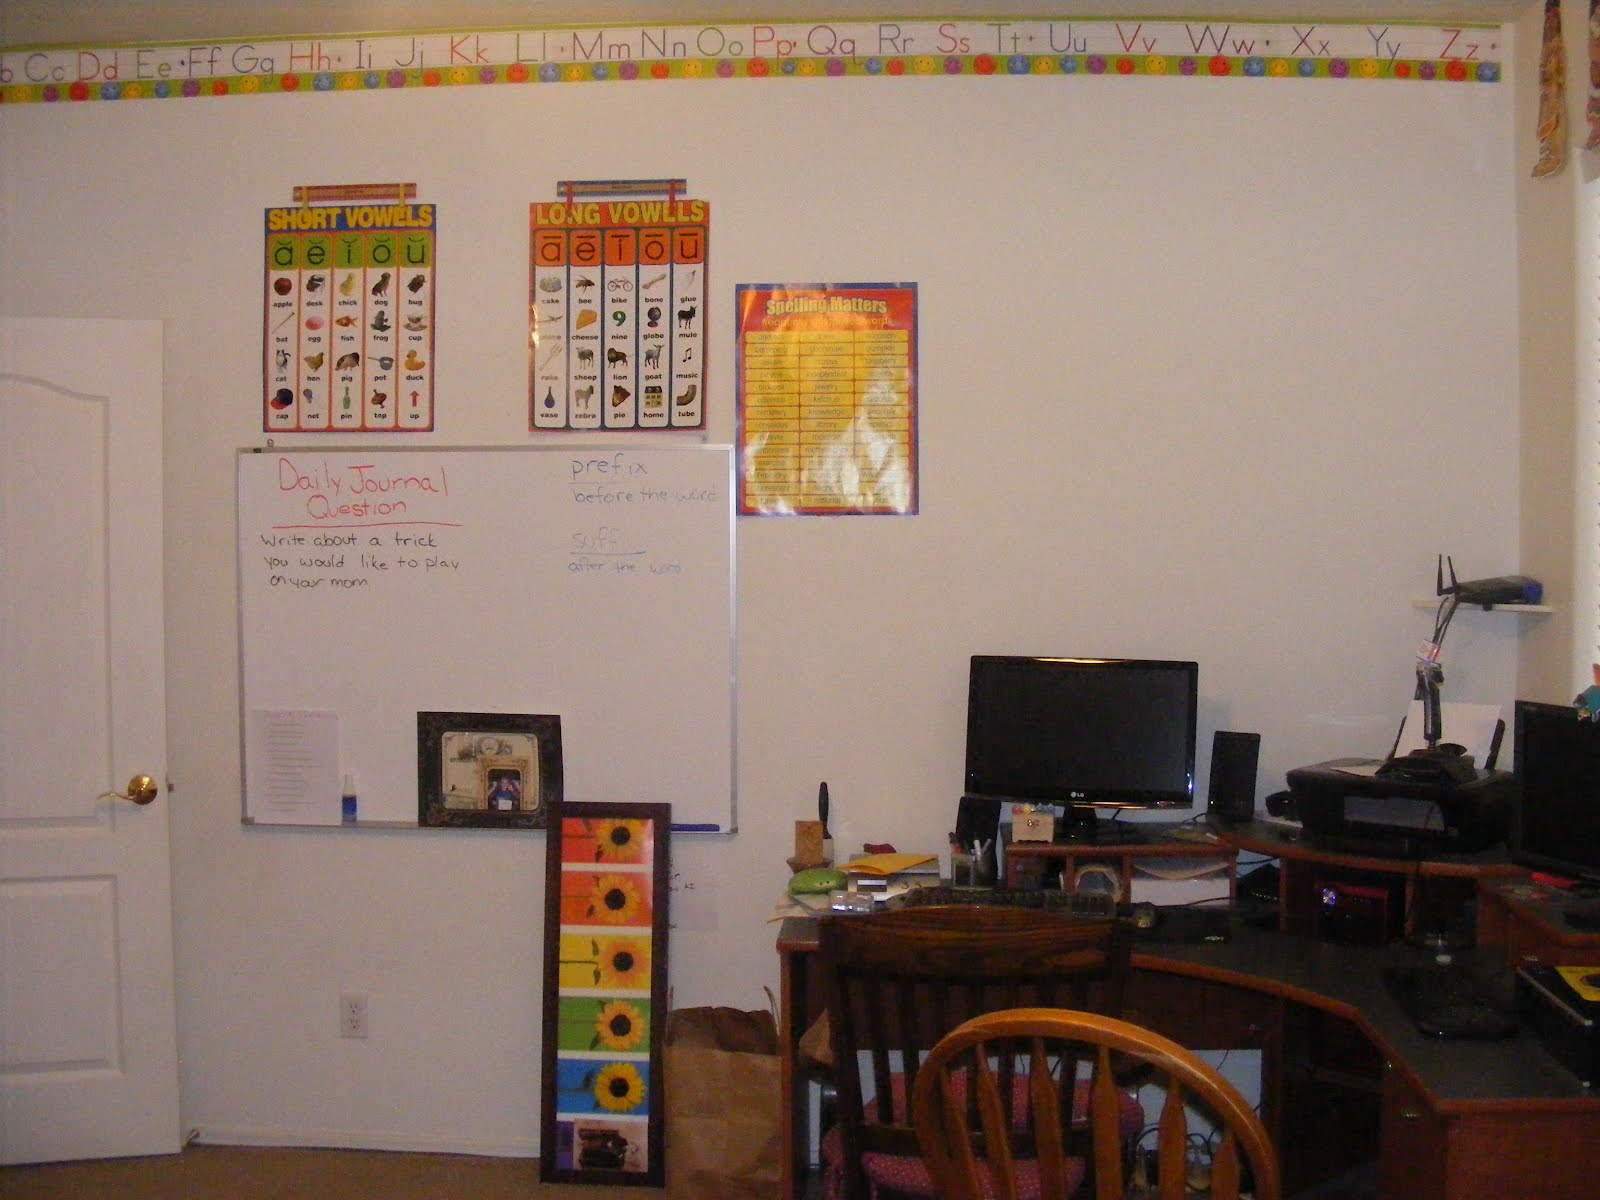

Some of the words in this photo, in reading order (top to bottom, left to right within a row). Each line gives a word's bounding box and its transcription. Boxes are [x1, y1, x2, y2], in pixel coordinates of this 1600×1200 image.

[268, 208, 341, 230] SHORT
[345, 204, 432, 227] VOWELS
[536, 202, 600, 224] LONG
[374, 299, 388, 307] dog
[408, 299, 423, 307] bug
[680, 296, 697, 304] glue
[766, 297, 827, 315] Spelling
[830, 296, 888, 314] Matters
[612, 311, 627, 327] 9
[643, 332, 664, 340] globe
[572, 453, 648, 480] prefix
[279, 457, 341, 495] Daily
[348, 465, 449, 496] Journal
[573, 486, 633, 504] before
[640, 486, 668, 502] the
[307, 495, 407, 519] Question
[261, 534, 305, 547] Write
[313, 533, 357, 546] about
[369, 537, 382, 546] a
[395, 531, 437, 547] trick
[264, 556, 288, 570] you
[300, 554, 344, 568] would
[361, 554, 388, 570] like
[397, 556, 418, 568] to
[425, 555, 459, 572] play
[290, 578, 324, 588] your
[331, 578, 368, 588] mom
